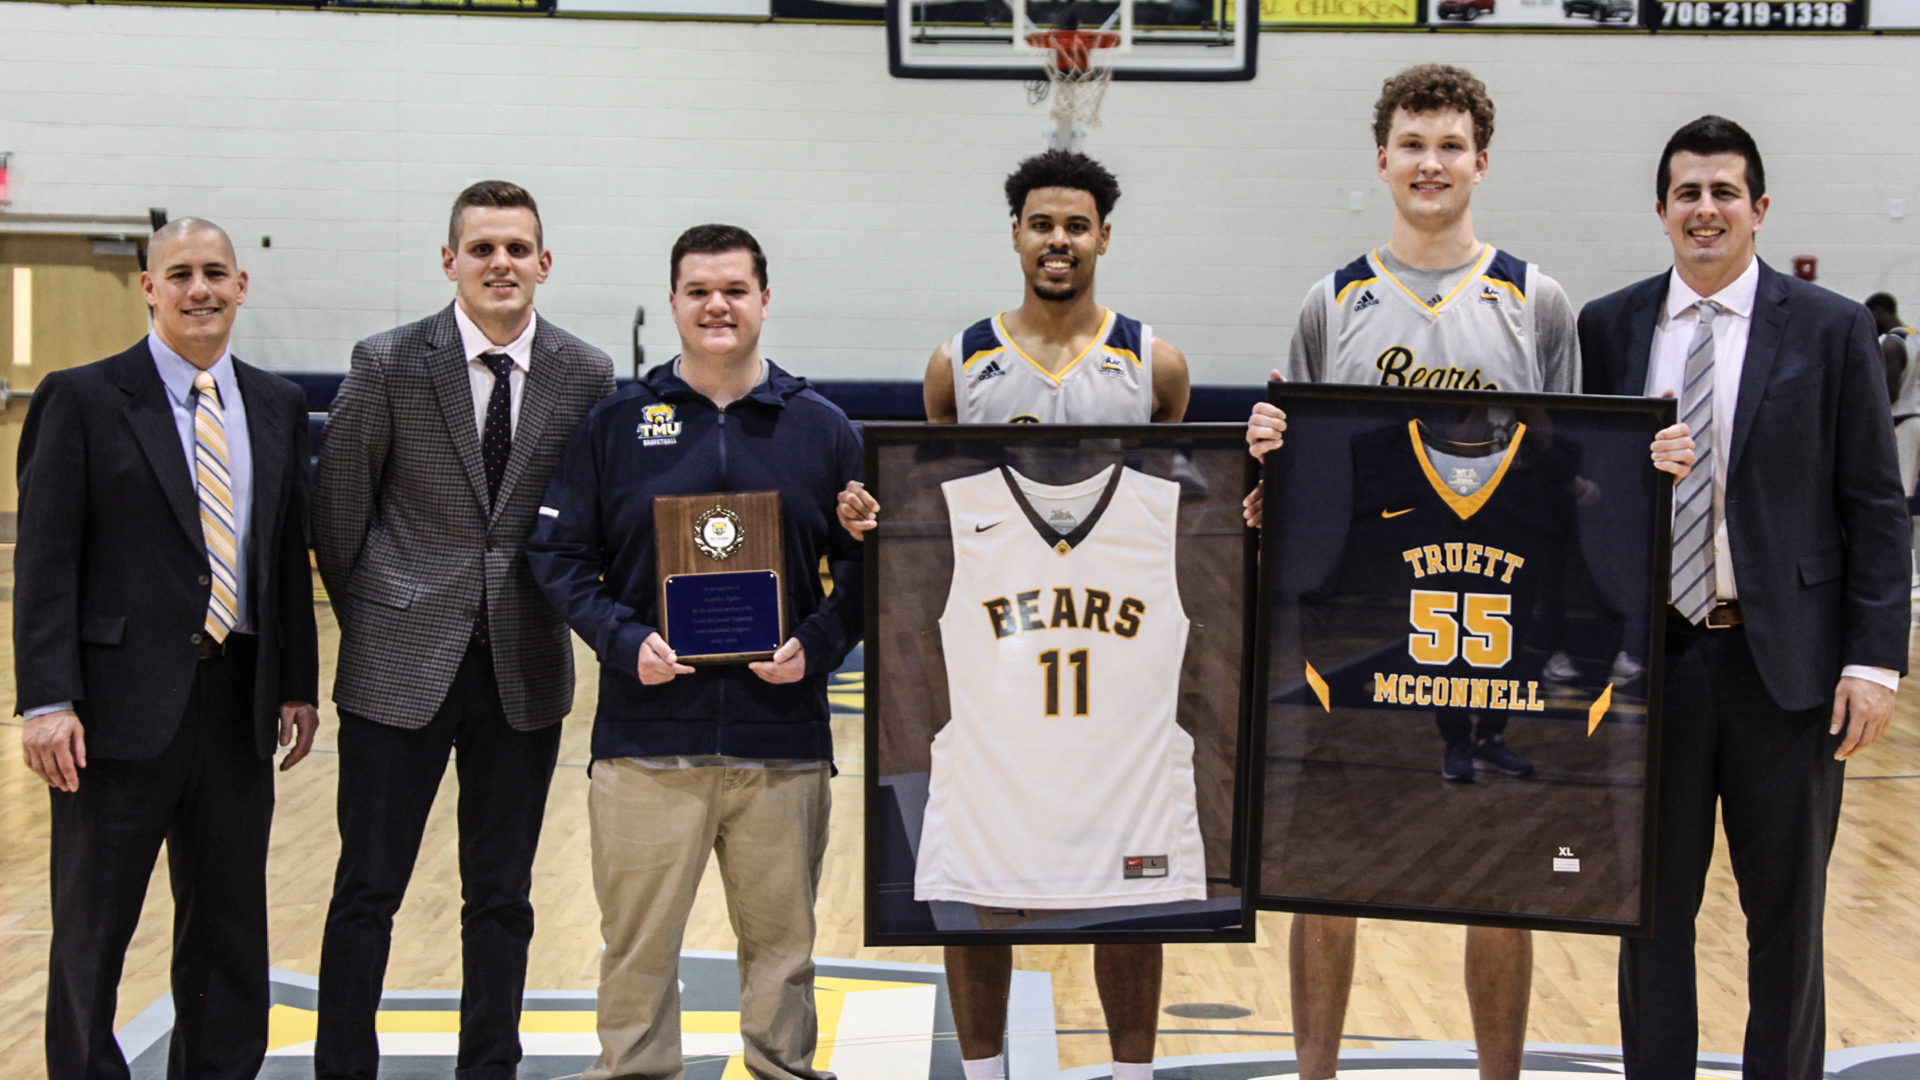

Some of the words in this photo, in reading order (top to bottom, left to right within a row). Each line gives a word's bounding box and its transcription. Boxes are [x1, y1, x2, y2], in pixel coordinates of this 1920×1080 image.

[1294, 0, 1408, 18] CHICKEN
[1661, 2, 1847, 26] 706-219-1338
[639, 422, 681, 437] TMU
[643, 438, 677, 446] BASKETBALL
[1402, 542, 1525, 584] TRUETT
[981, 586, 1147, 641] BEARS
[1408, 589, 1513, 669] 55
[1037, 647, 1090, 718] 11
[1373, 672, 1545, 712] MCCONNELL
[1150, 859, 1157, 867] L
[1558, 846, 1574, 857] XL
